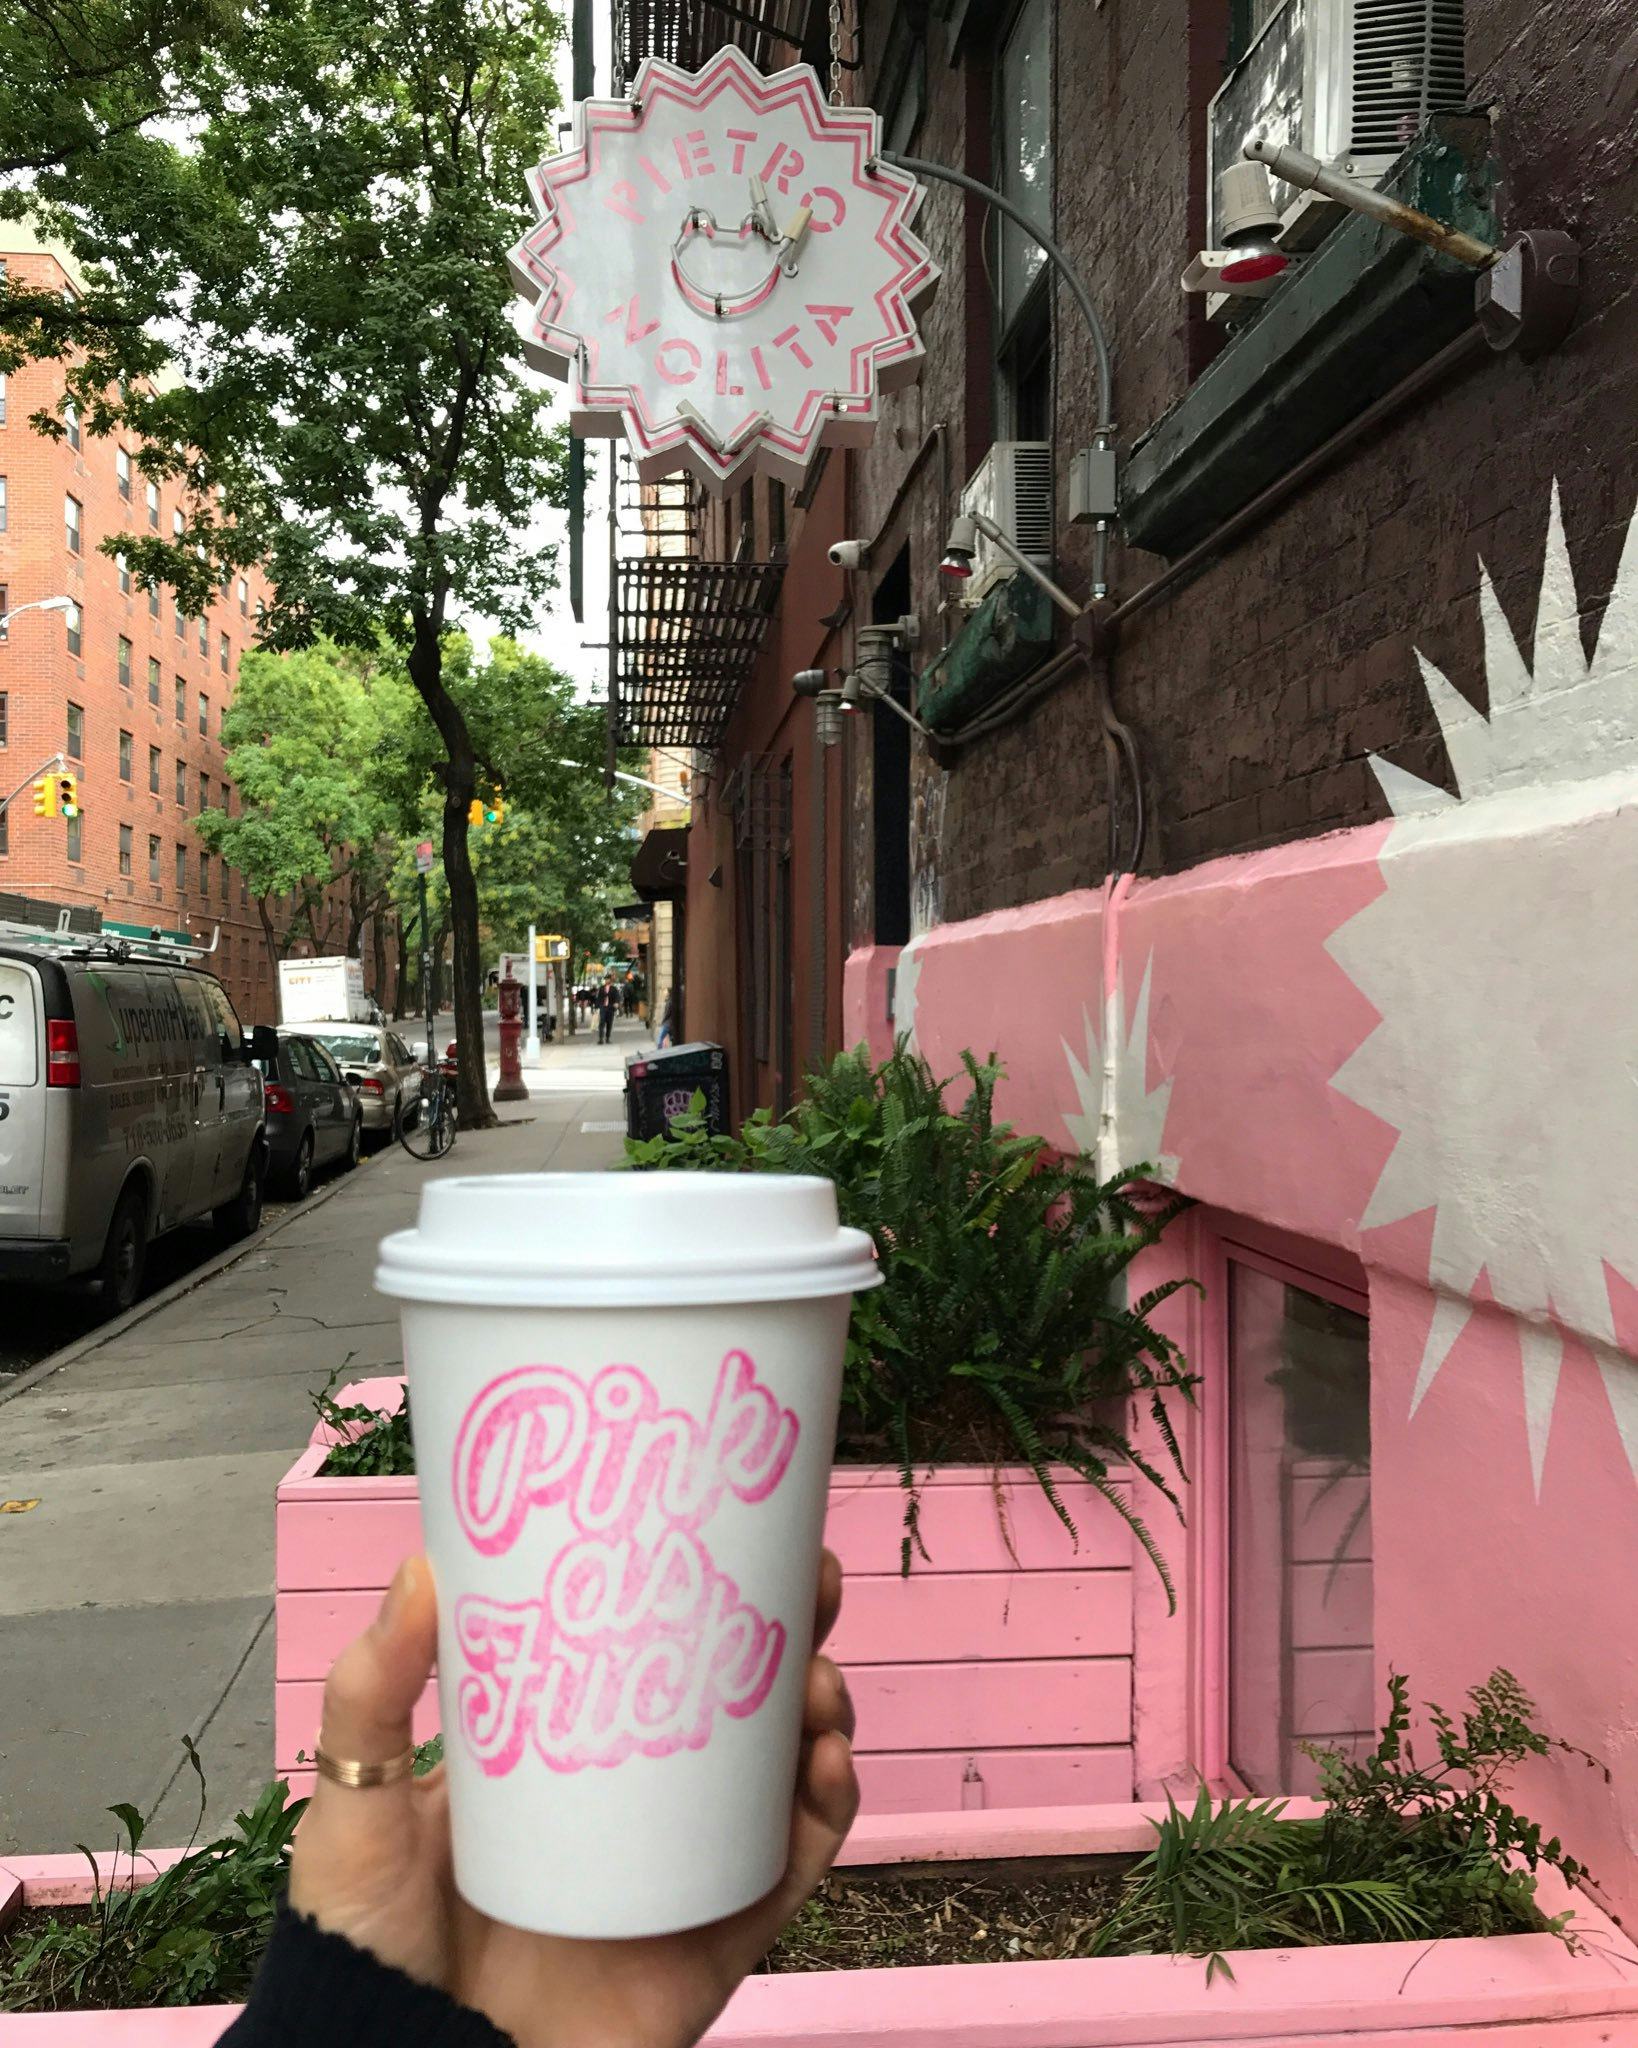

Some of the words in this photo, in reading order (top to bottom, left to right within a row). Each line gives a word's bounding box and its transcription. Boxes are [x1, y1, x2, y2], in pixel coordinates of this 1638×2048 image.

[602, 128, 847, 234] PIETRO
[604, 293, 855, 397] NOLITA
[452, 1348, 800, 1558] Pink
[544, 1522, 722, 1640] as
[454, 1572, 787, 1778] Fuck
